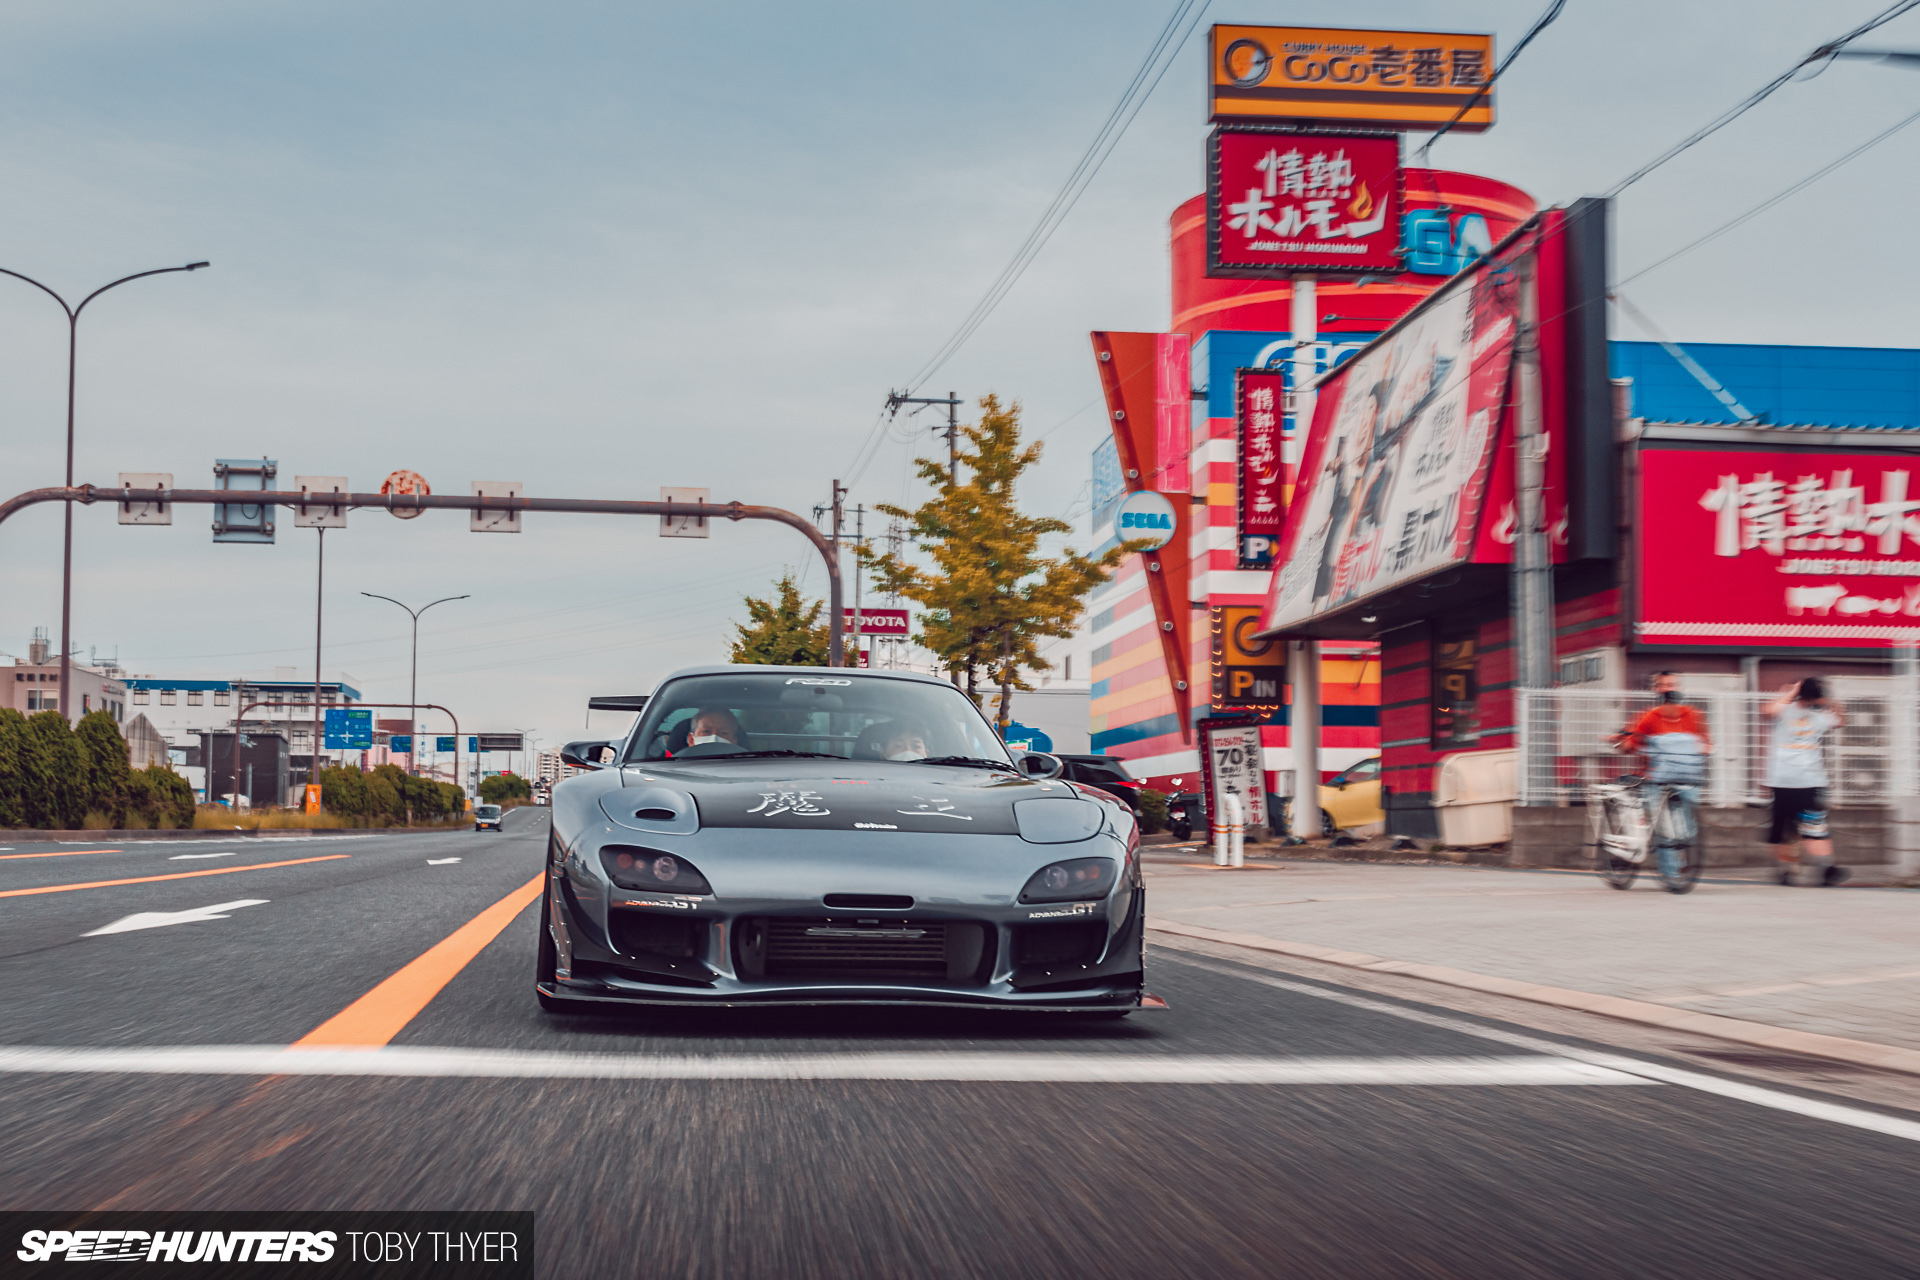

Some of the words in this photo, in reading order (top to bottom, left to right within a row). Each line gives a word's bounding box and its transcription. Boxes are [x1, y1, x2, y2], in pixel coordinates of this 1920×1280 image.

[1255, 147, 1356, 199] 情熱
[1225, 188, 1389, 240] ホルモン
[1121, 512, 1172, 530] SEGA
[1216, 748, 1244, 766] 70
